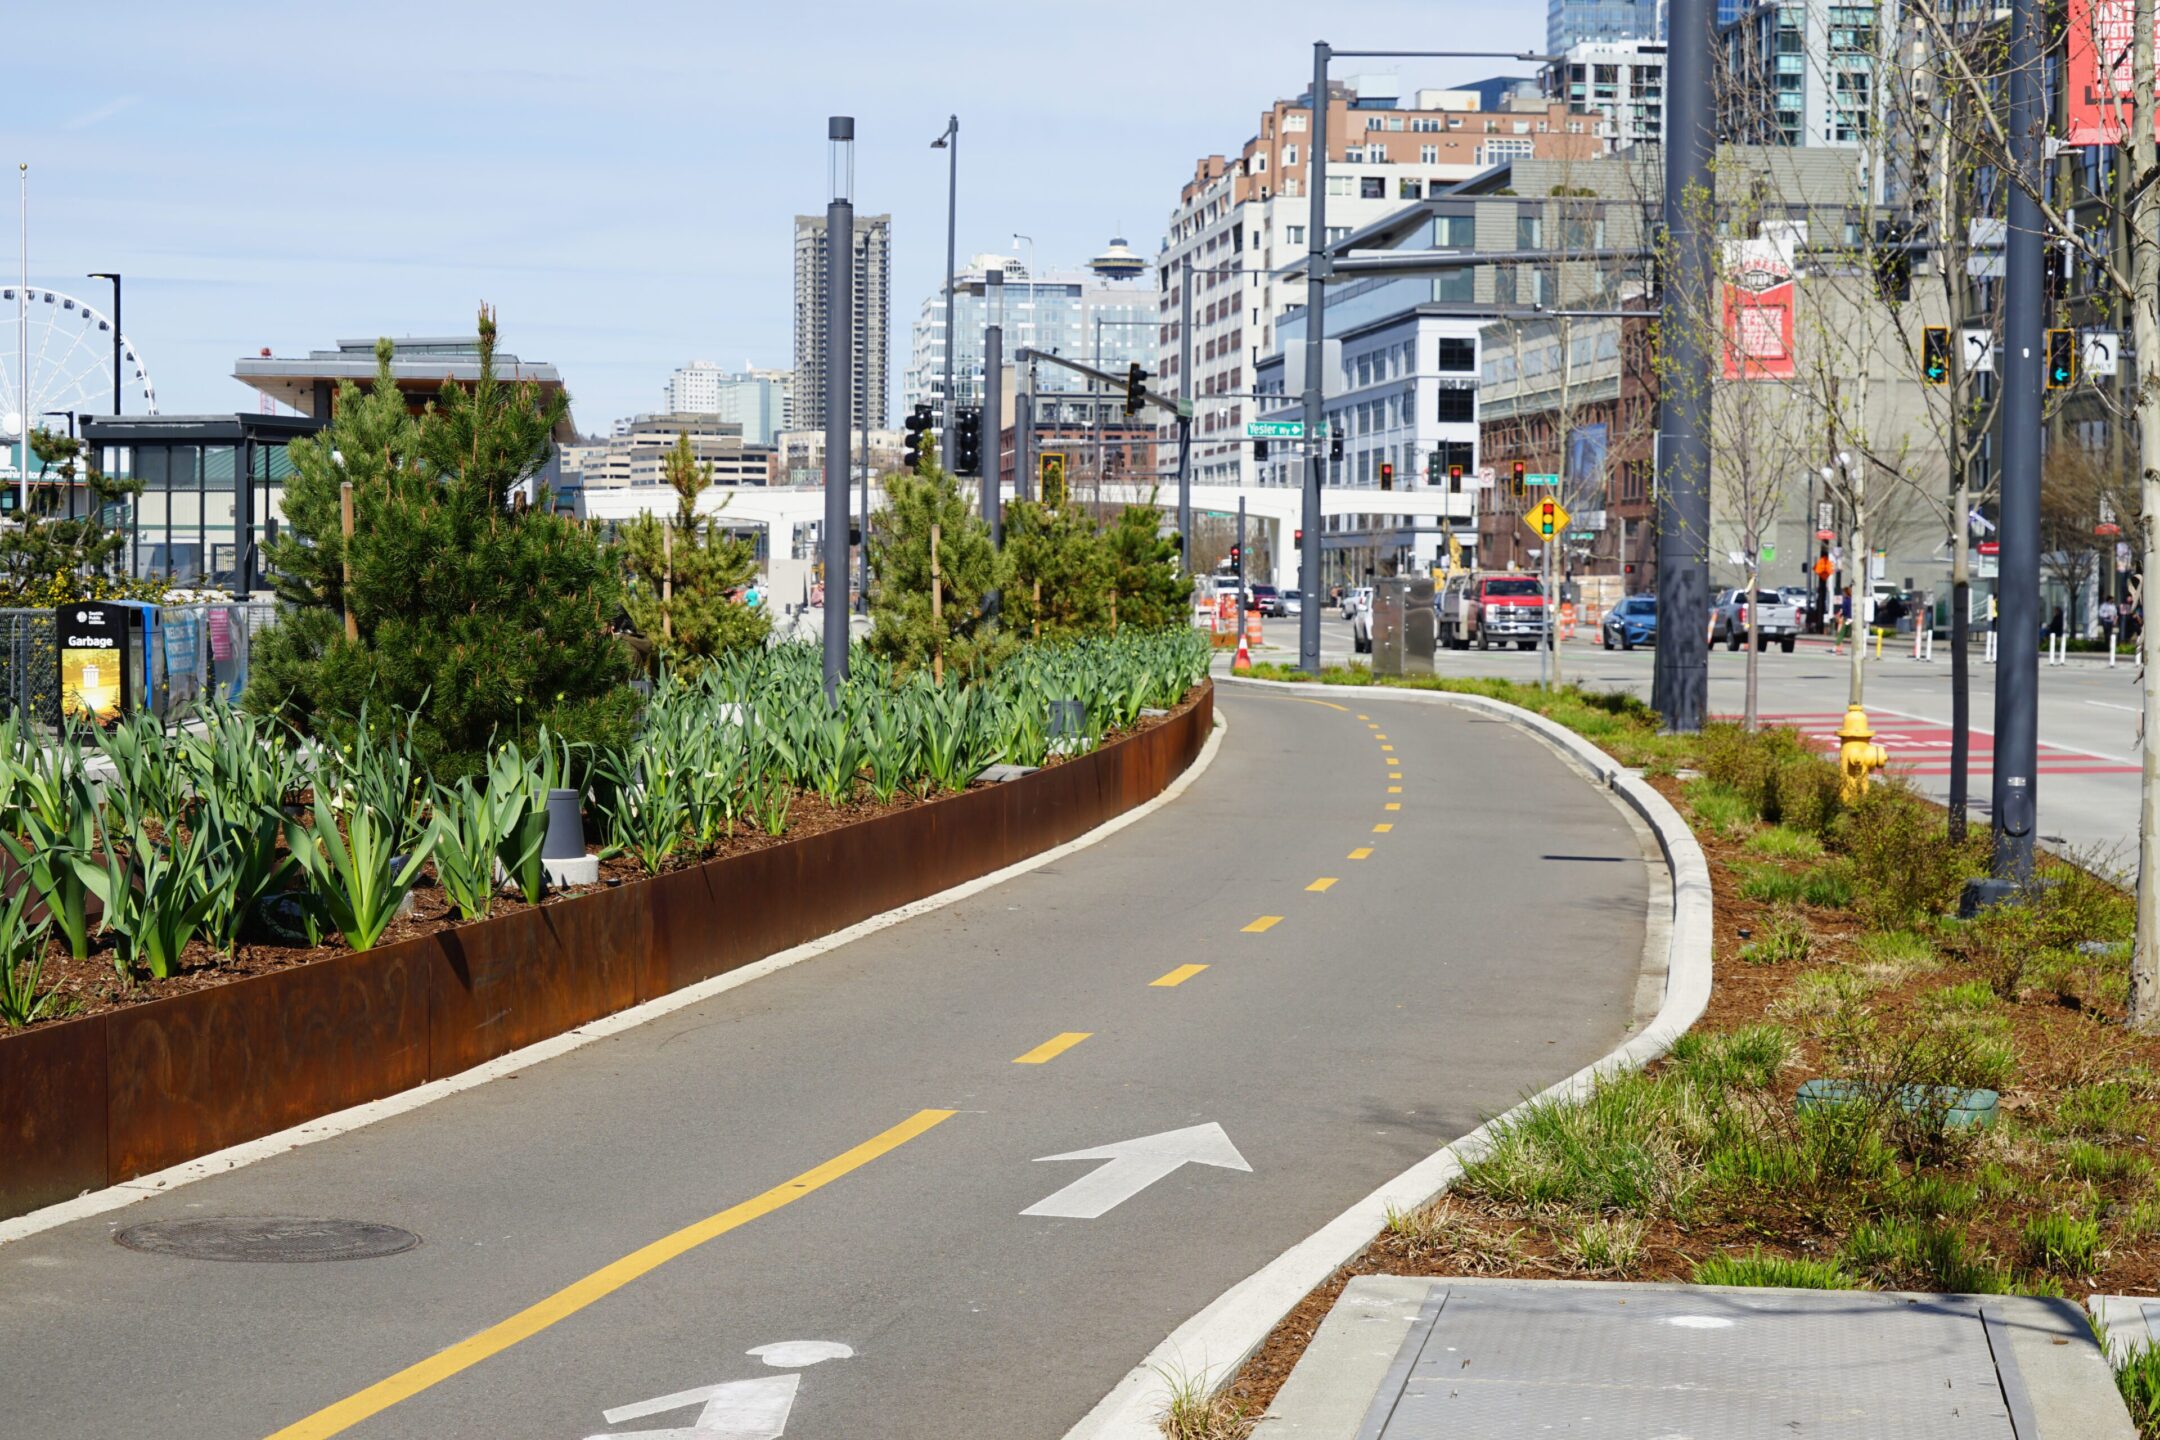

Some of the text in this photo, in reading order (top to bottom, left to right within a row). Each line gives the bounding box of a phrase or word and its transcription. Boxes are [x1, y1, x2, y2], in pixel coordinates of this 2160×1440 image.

[1247, 423, 1291, 435] Yesler Wy
[68, 635, 113, 648] Garbage
